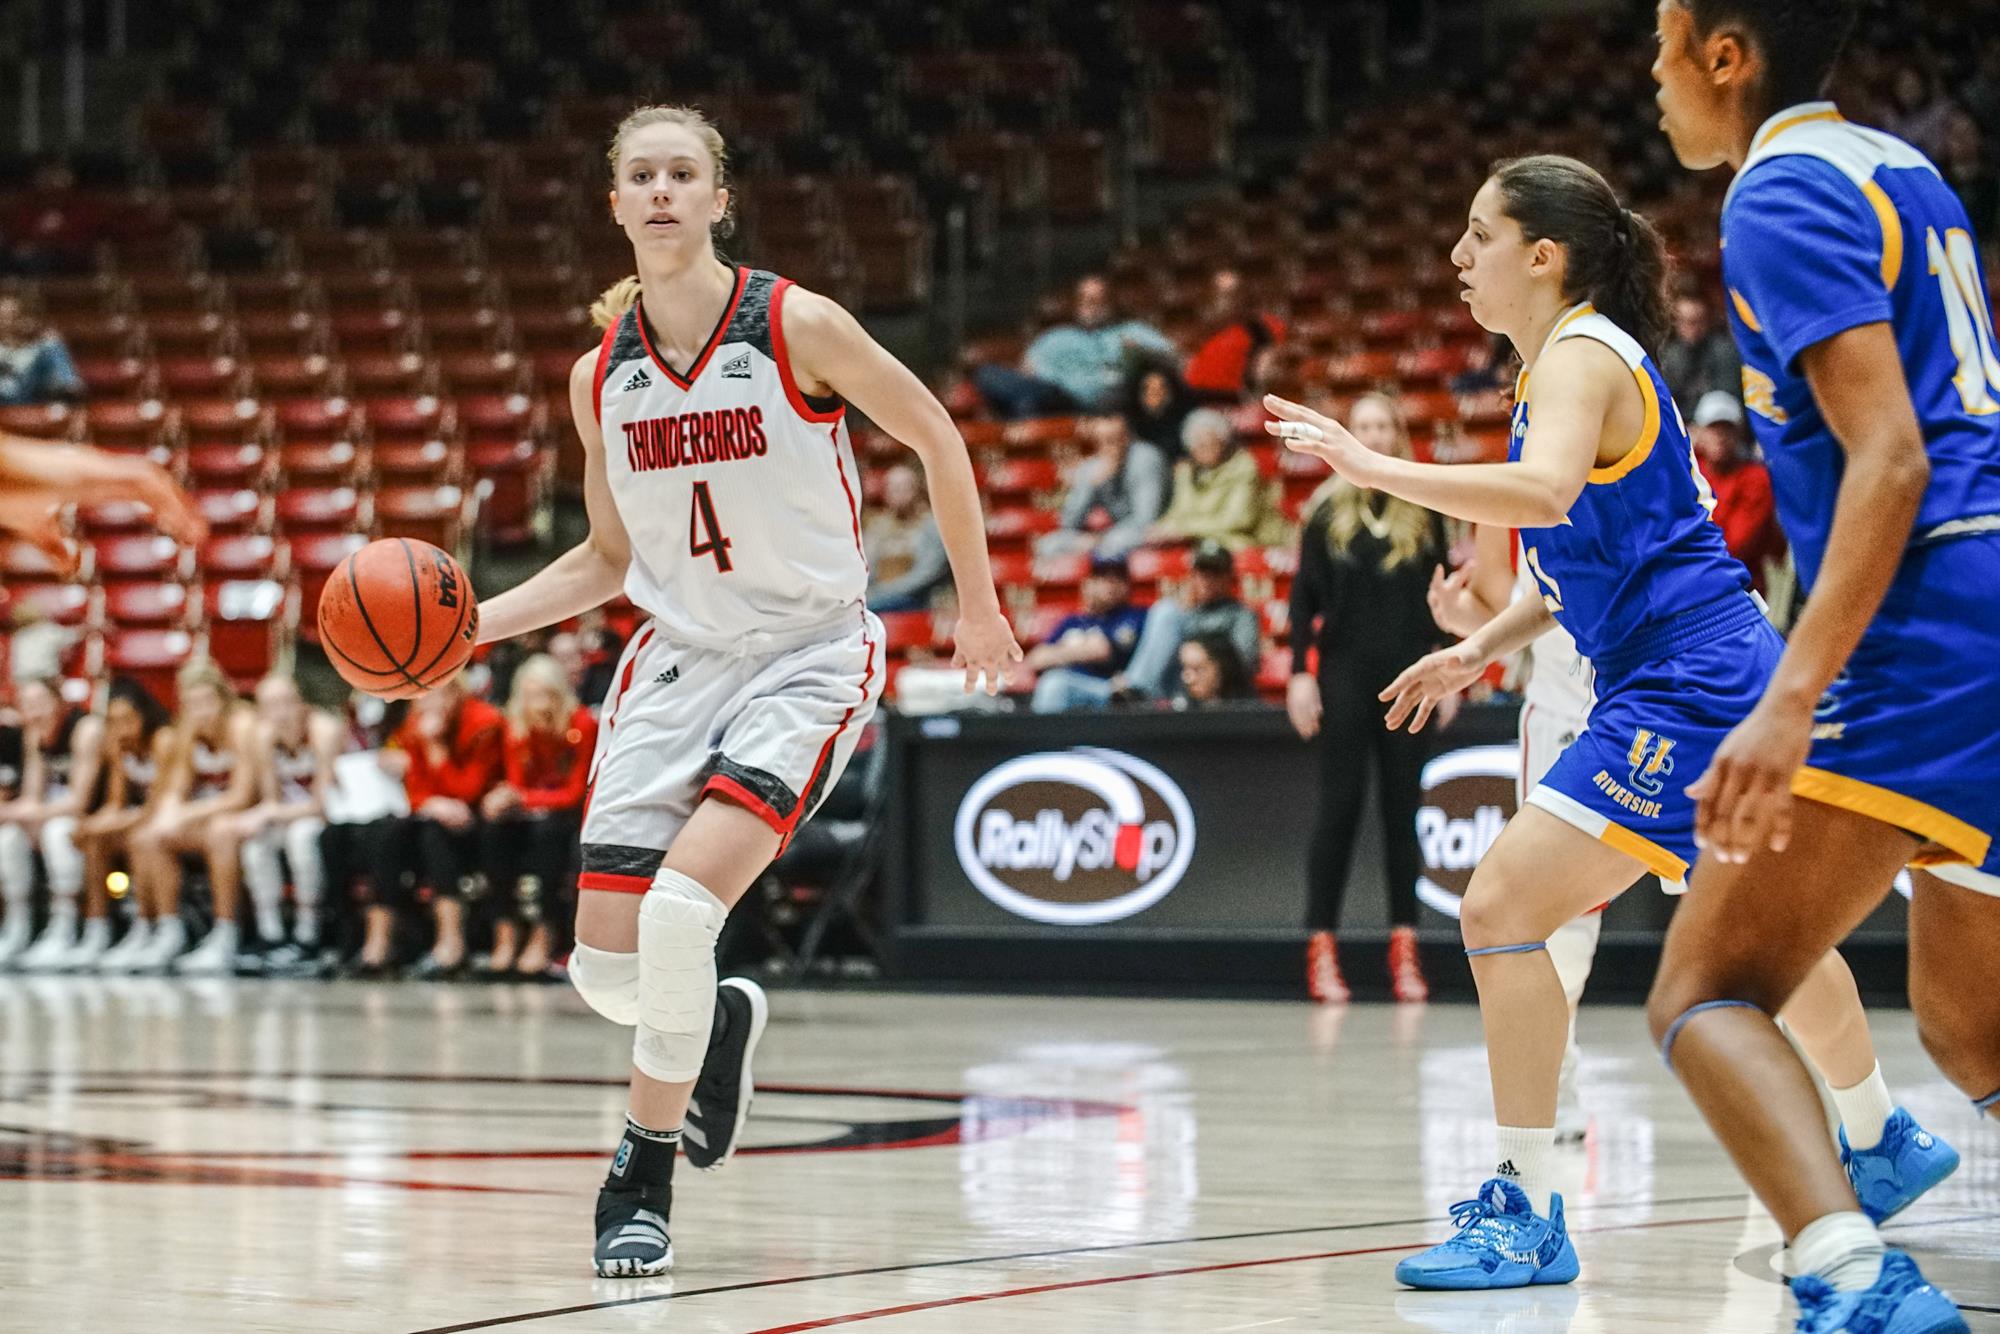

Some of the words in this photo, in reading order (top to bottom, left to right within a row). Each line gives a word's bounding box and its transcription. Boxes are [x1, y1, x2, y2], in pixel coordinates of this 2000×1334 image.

[1926, 225, 2000, 415] 10
[622, 405, 768, 472] THUNDERBIRDS
[690, 480, 733, 573] 4
[1592, 769, 1663, 819] RIVERSIDE
[1627, 727, 1677, 796] UC
